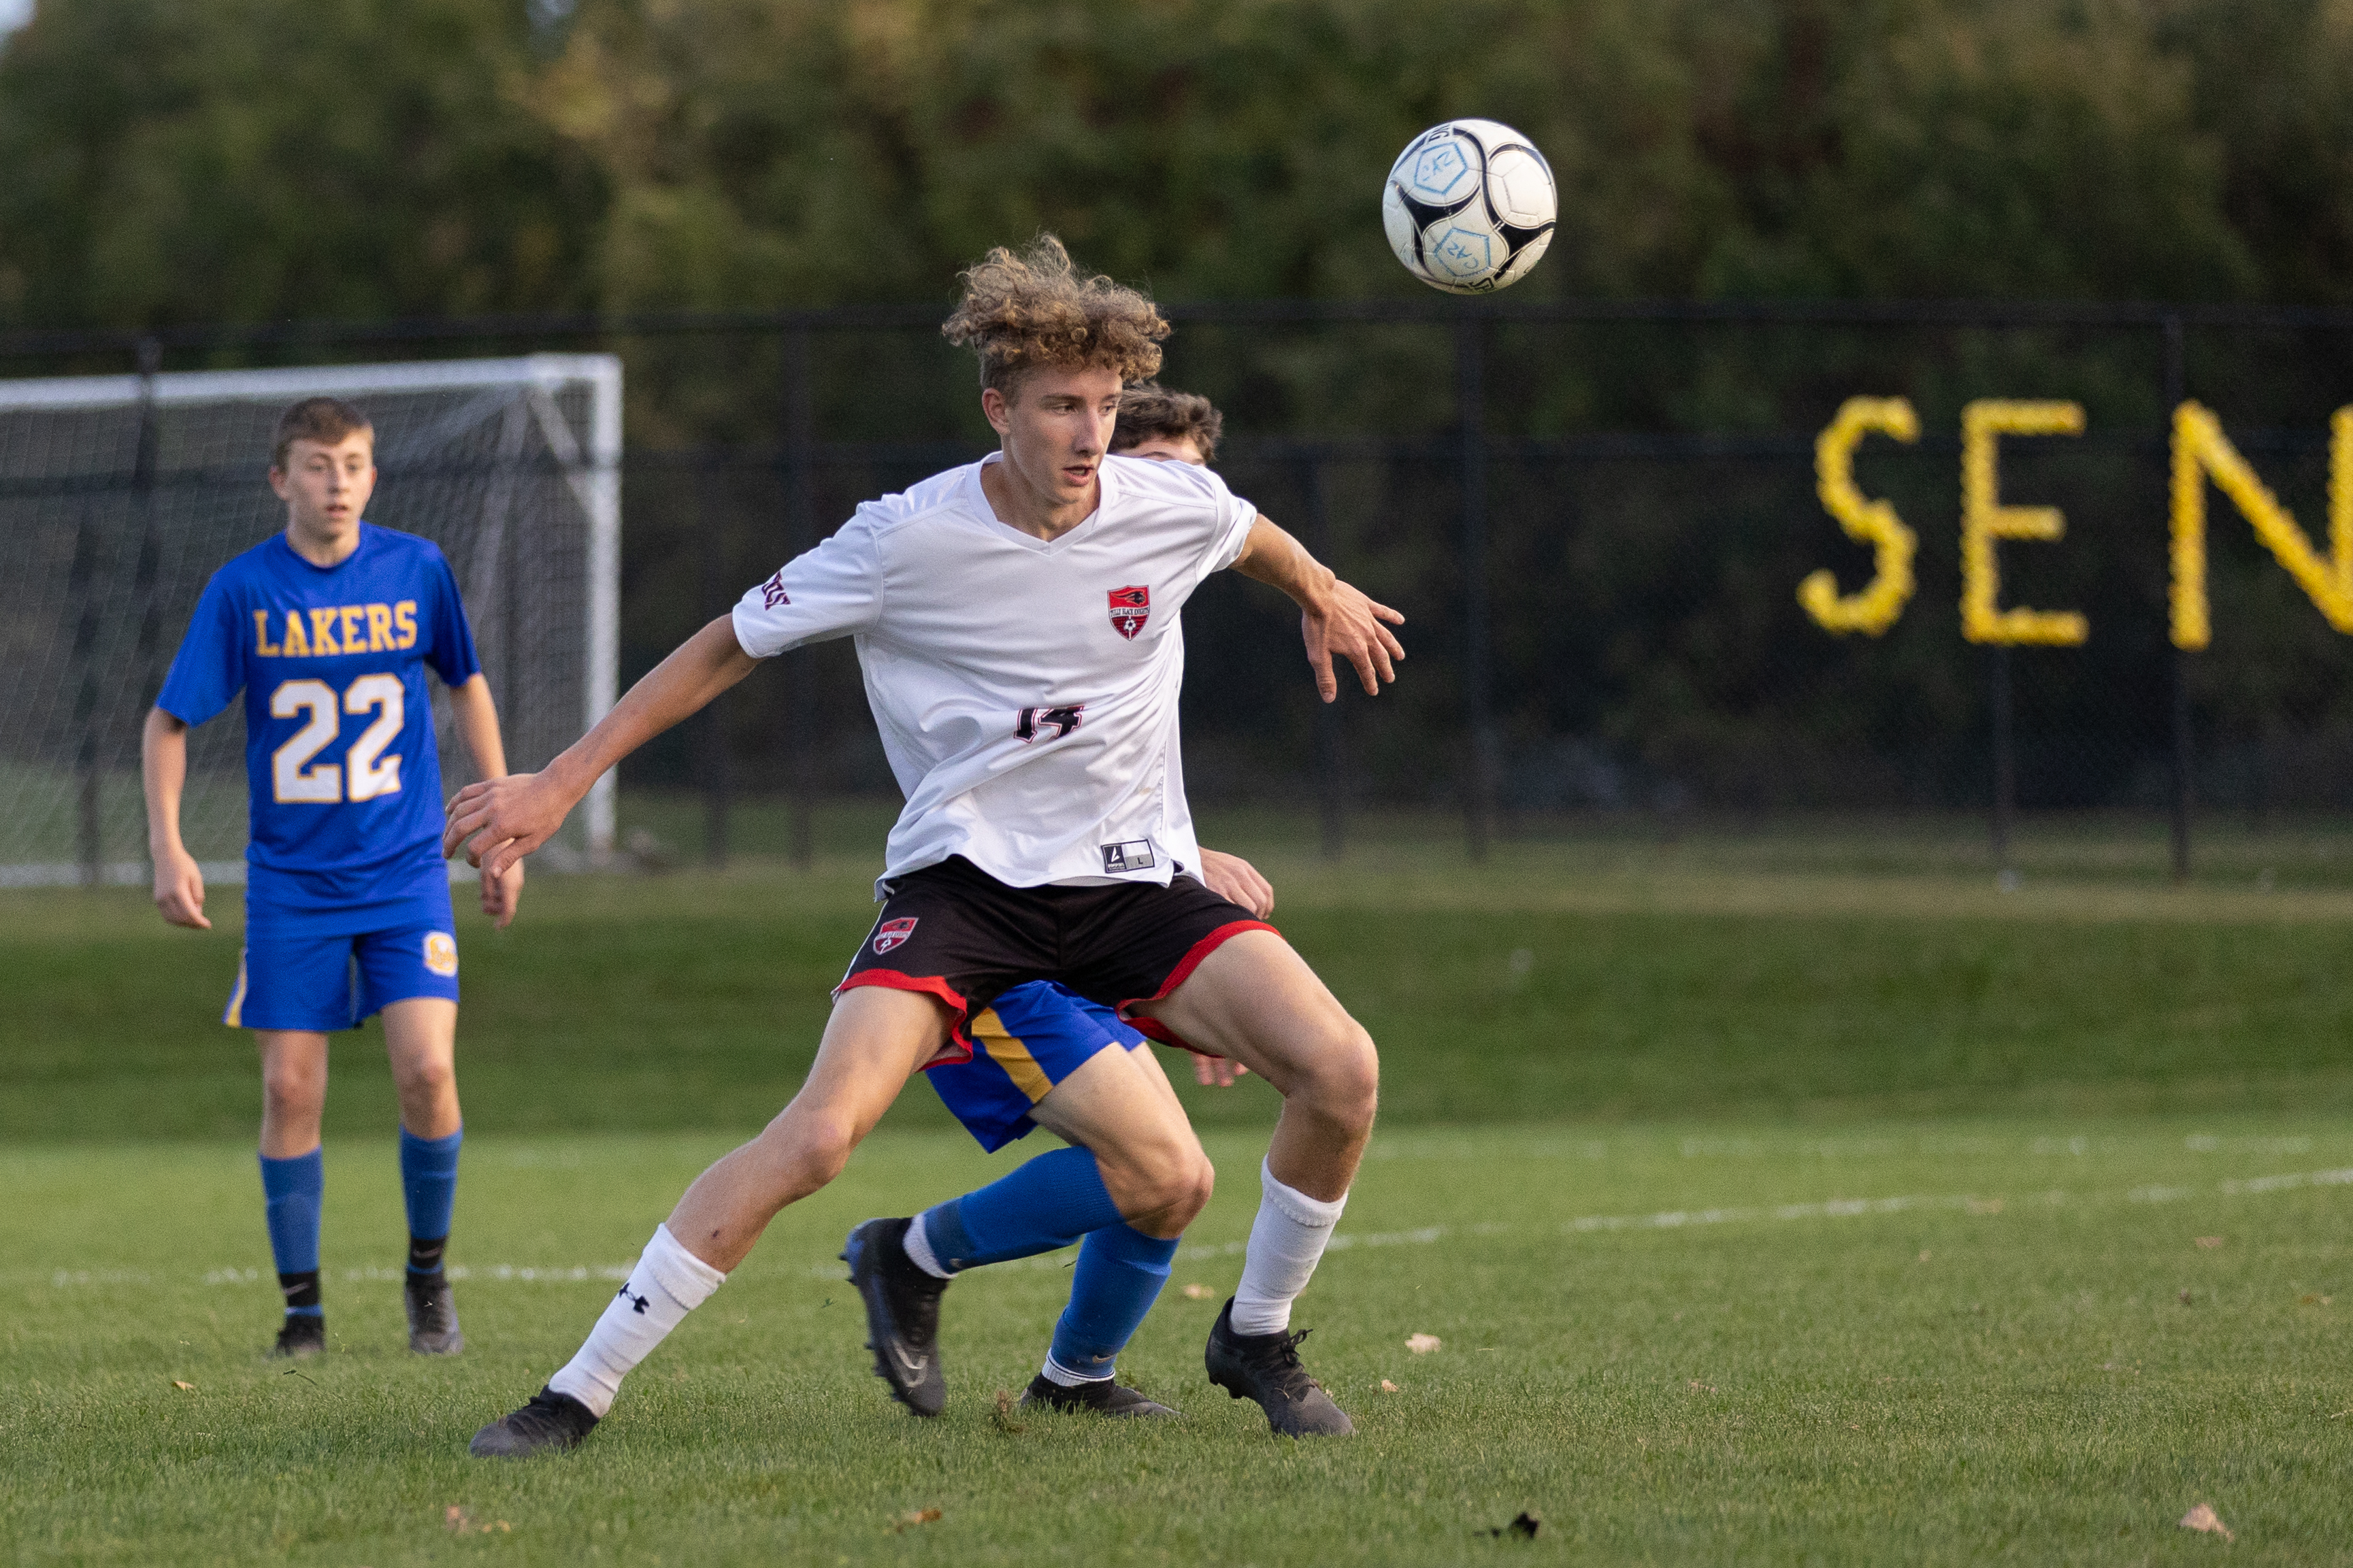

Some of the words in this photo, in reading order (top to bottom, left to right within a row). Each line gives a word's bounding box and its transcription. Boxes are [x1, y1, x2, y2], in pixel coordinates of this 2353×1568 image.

[252, 599, 418, 658] LAKERS
[269, 671, 406, 805] 22
[1013, 705, 1085, 744] 14
